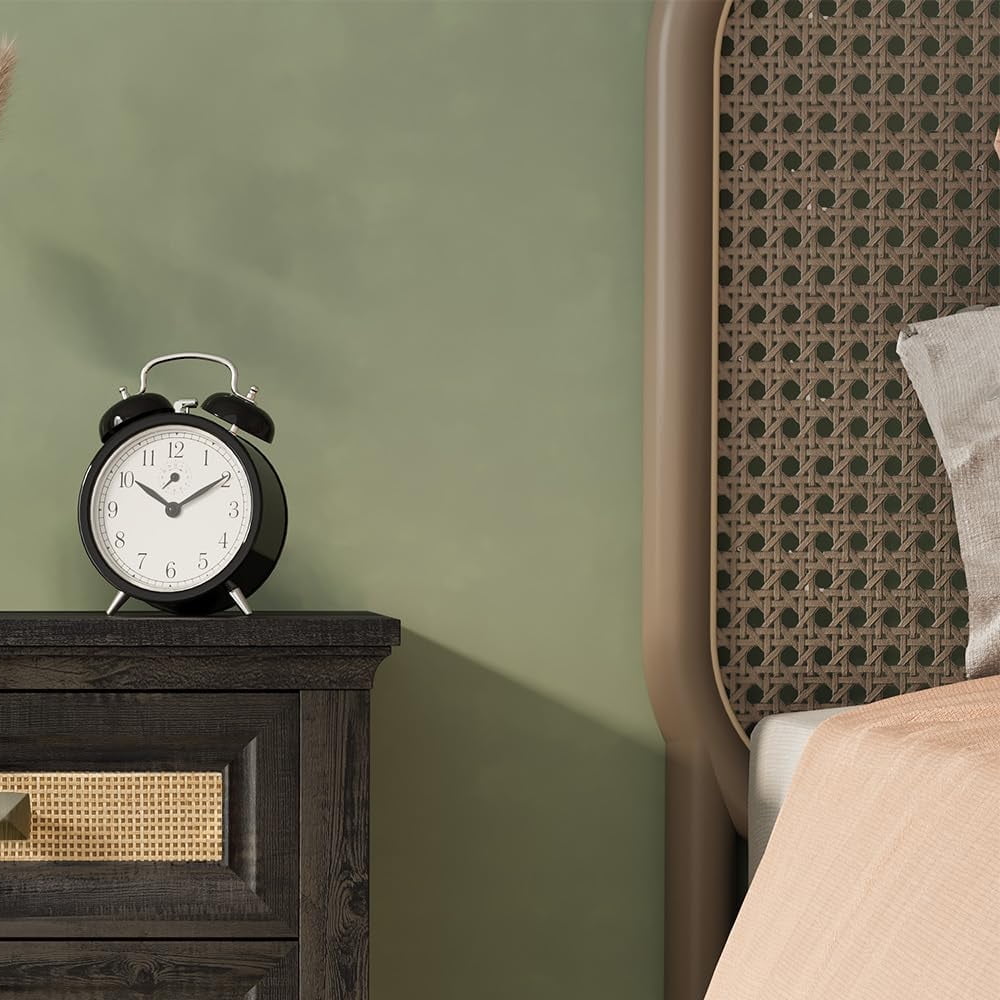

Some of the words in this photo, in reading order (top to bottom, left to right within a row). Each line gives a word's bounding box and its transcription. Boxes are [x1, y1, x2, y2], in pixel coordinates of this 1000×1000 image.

[143, 450, 155, 466] 11
[168, 441, 184, 458] 12
[204, 450, 209, 466] 1
[120, 471, 134, 488] 10
[221, 471, 231, 488] 2
[108, 501, 118, 518] 9
[229, 501, 239, 518] 3
[114, 531, 125, 548] 8
[218, 532, 228, 548] 4
[137, 553, 147, 569] 7
[166, 561, 176, 578] 6
[198, 553, 208, 569] 5
